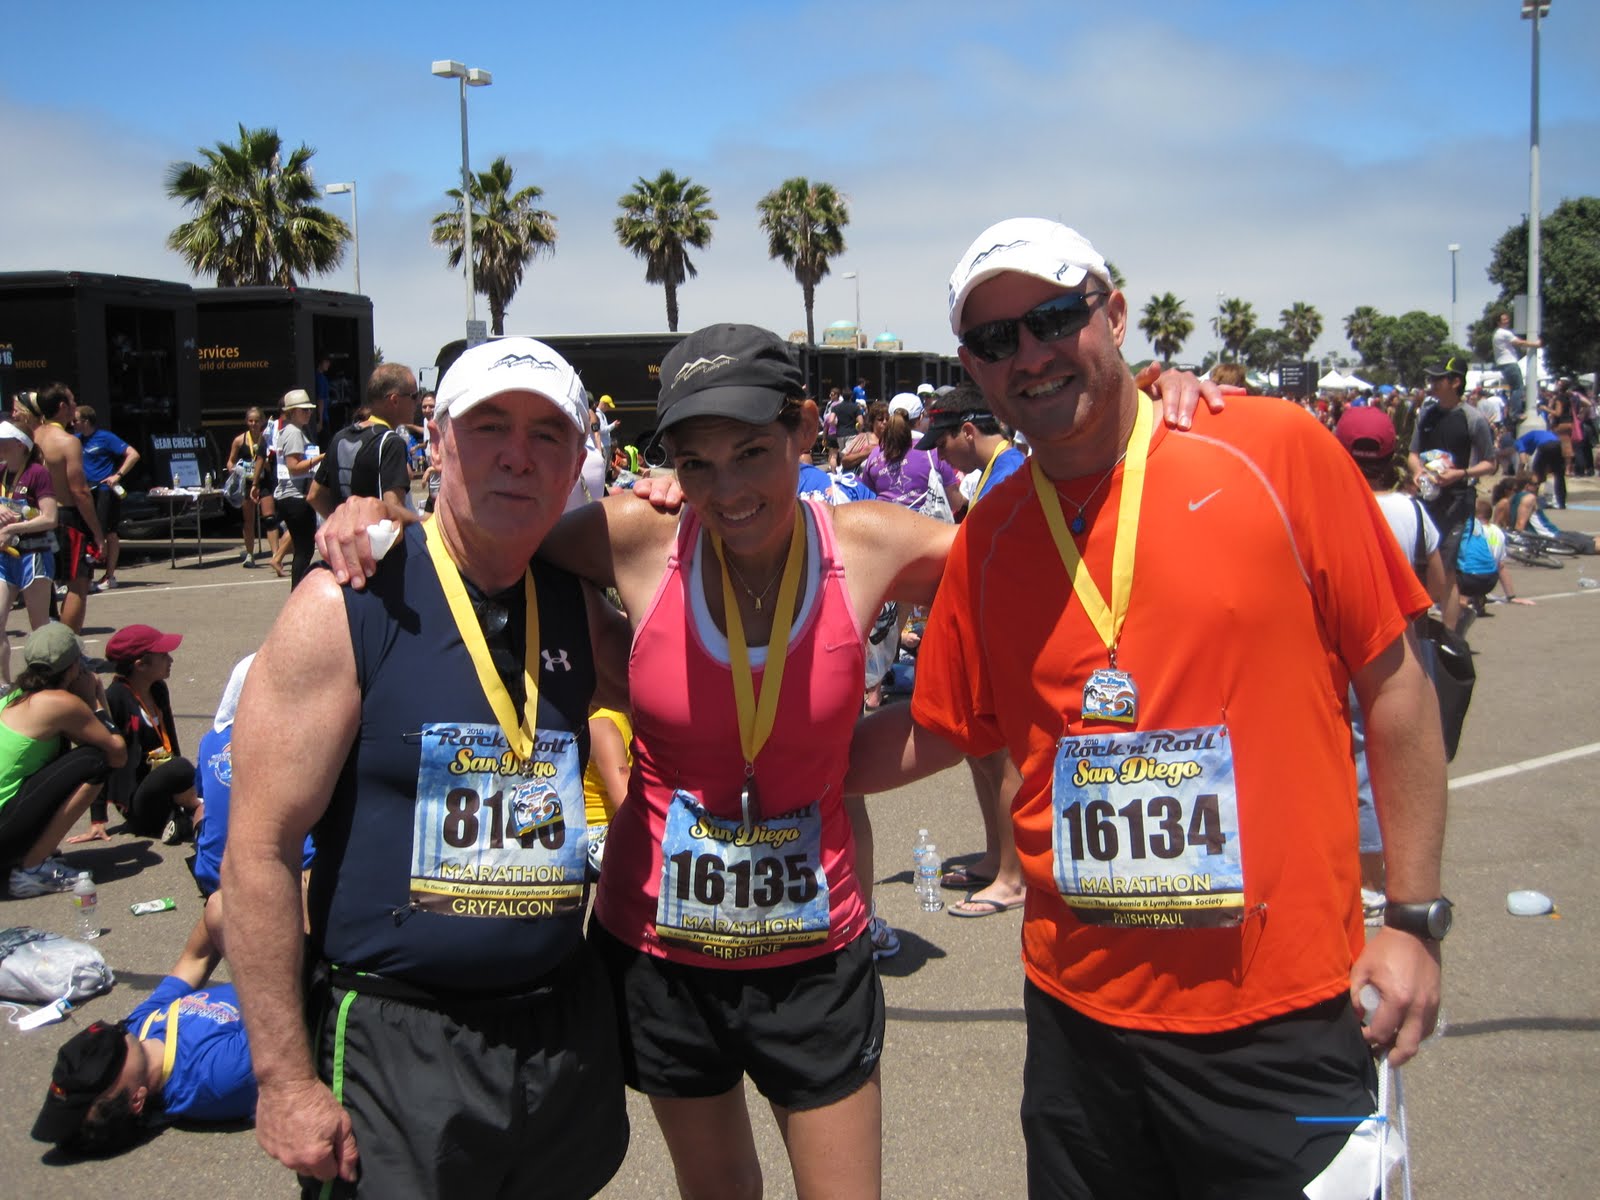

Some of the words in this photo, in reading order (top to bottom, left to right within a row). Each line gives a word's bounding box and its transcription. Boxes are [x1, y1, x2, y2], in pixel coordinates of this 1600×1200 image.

[217, 360, 225, 369] of
[227, 359, 270, 369] commerce
[154, 437, 172, 449] GEAR
[172, 436, 193, 449] CHECK
[436, 728, 505, 747] Rock
[1065, 740, 1124, 758] Rock
[1150, 733, 1216, 753] Roll
[448, 748, 499, 776] San
[1072, 759, 1117, 788] San
[1118, 756, 1202, 788] Diego
[689, 816, 734, 841] San
[734, 824, 800, 848] Diego
[1062, 793, 1226, 861] 16134
[441, 863, 565, 882] MARATHON
[670, 849, 818, 908] 16135
[452, 886, 465, 894] The
[466, 887, 504, 896] Leukemia
[505, 888, 511, 896] &
[512, 888, 550, 898] Lymphoma
[552, 888, 571, 896] Society
[1080, 874, 1211, 894] MARATHON
[452, 898, 554, 917] GRYFALCON
[1107, 899, 1141, 907] Leukemia
[1149, 900, 1192, 908] Lymphoma
[1195, 898, 1225, 906] Society
[682, 913, 804, 935] MARATHON
[1114, 912, 1185, 925] PHISHYPAUL
[692, 934, 705, 942] The
[706, 935, 740, 945] Leukemia
[787, 934, 811, 942] Society
[702, 944, 781, 960] CHRISTINE
